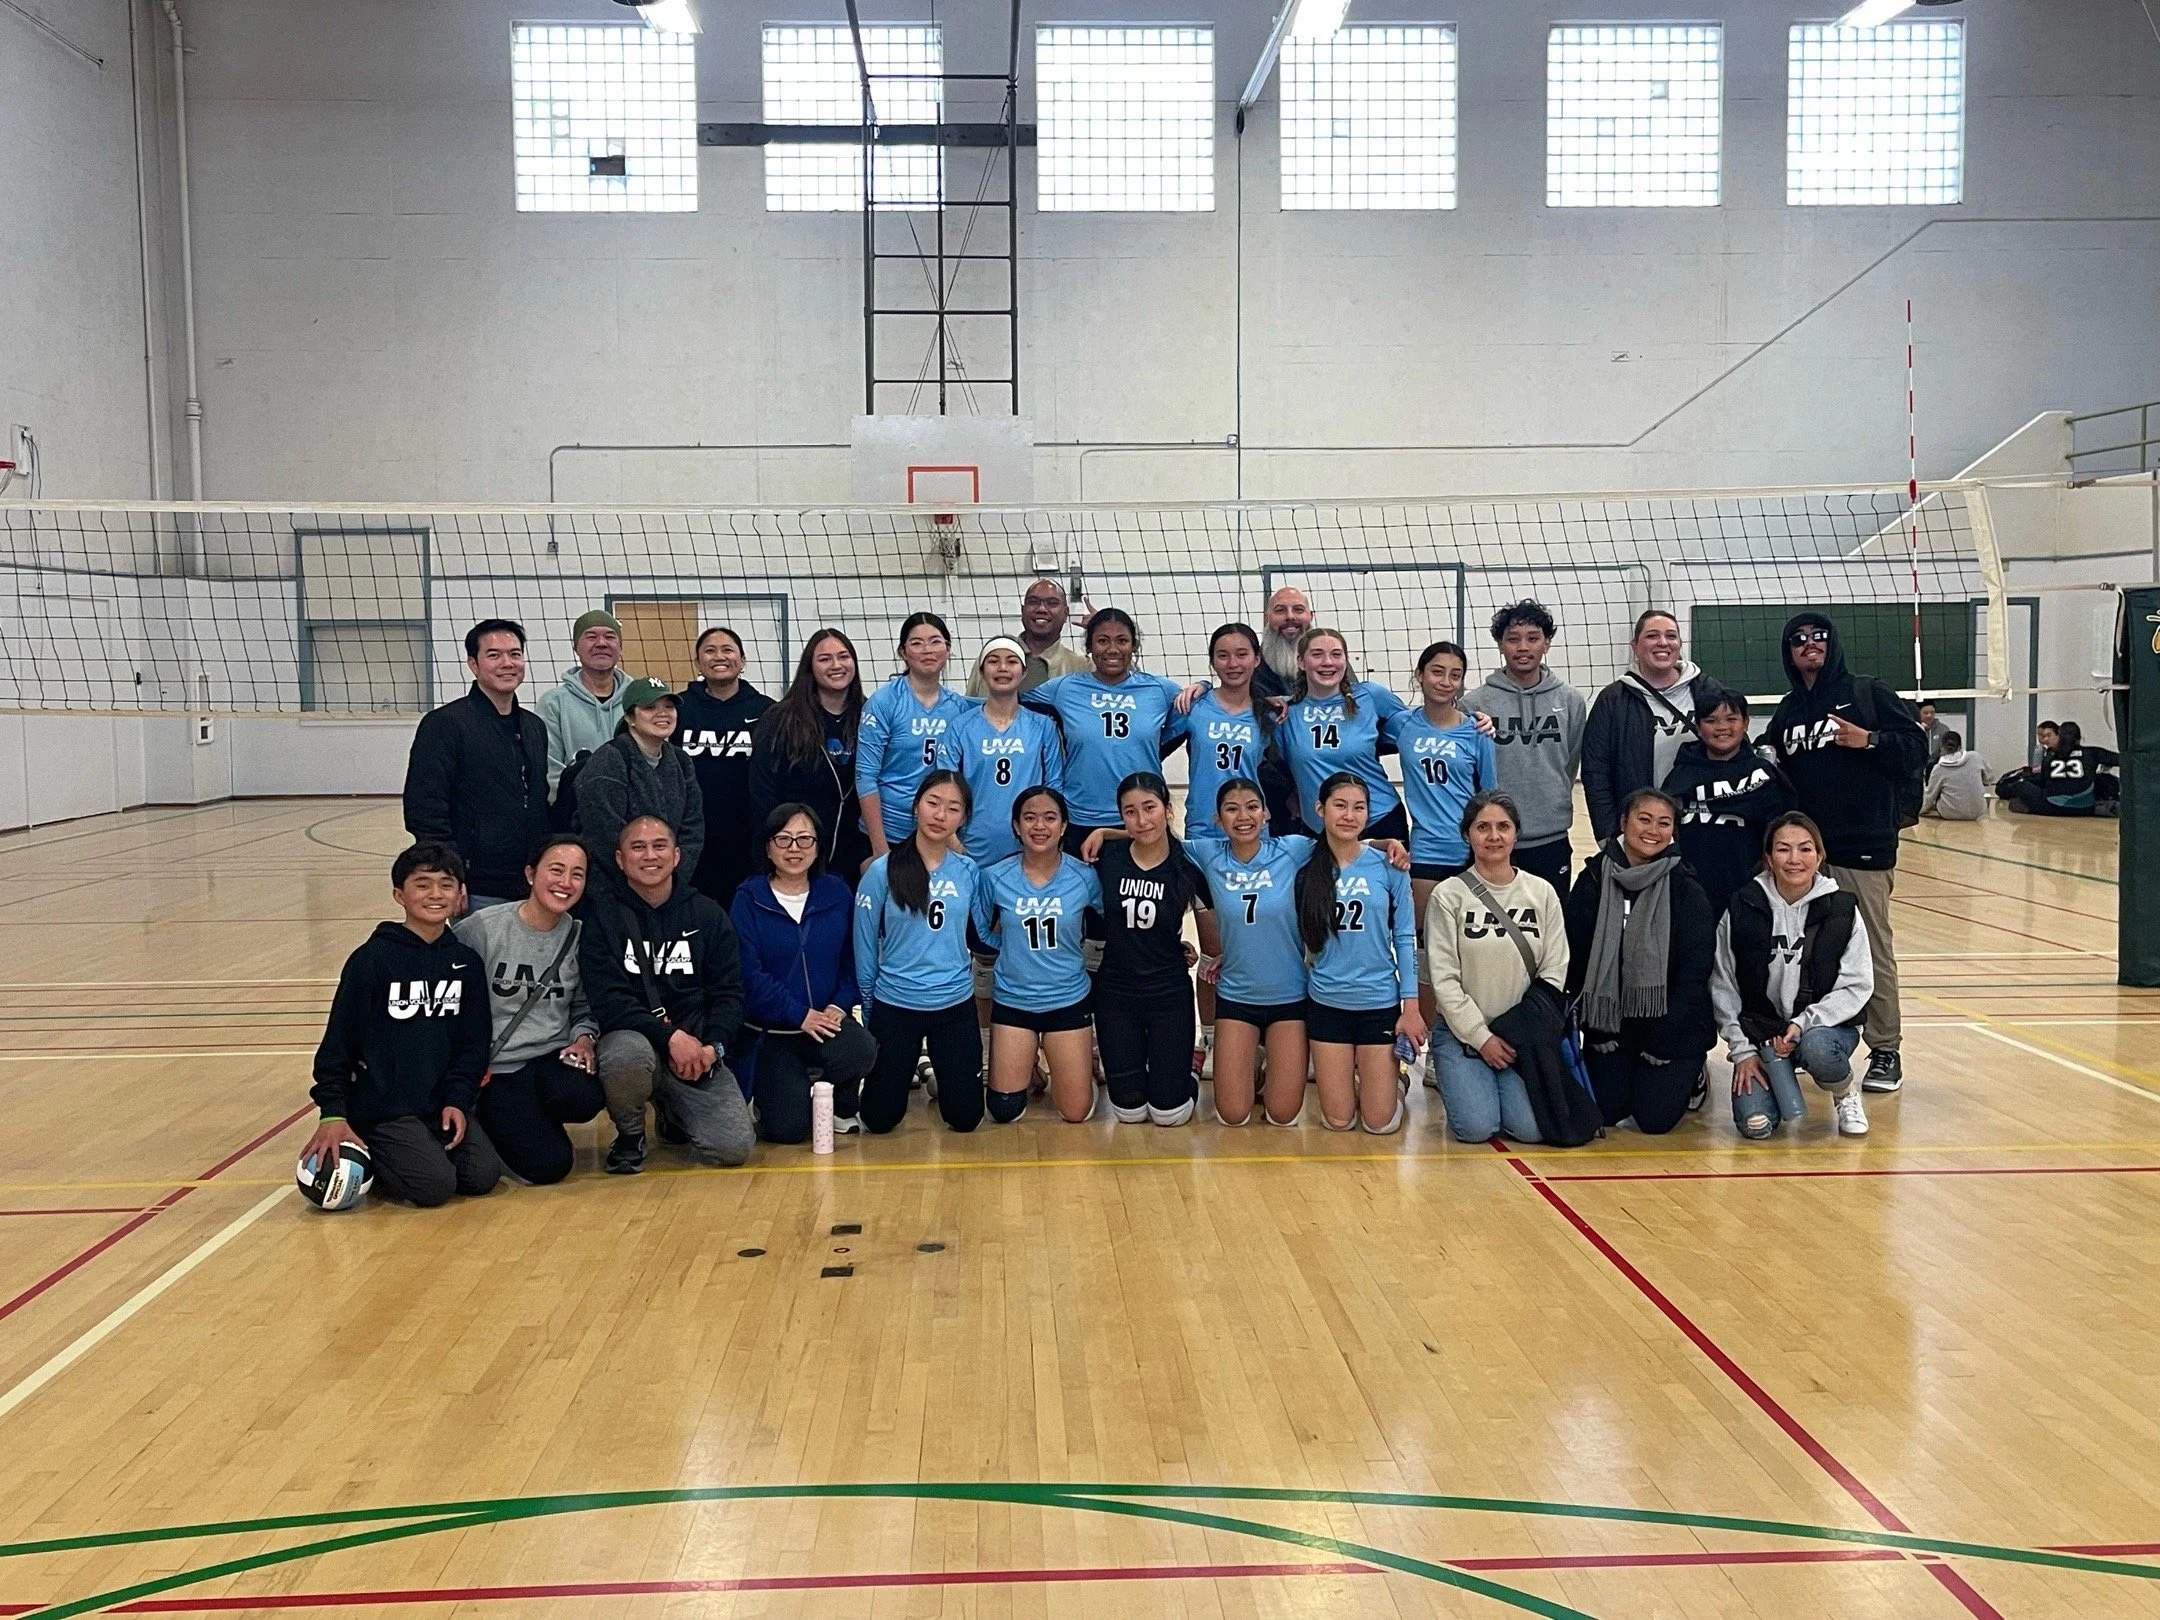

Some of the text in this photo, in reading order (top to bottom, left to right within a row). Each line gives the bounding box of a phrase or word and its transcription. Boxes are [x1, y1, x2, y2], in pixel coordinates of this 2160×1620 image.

[1090, 693, 1137, 710] UVA
[1303, 705, 1346, 723] UVA
[911, 717, 947, 736] UVA
[1100, 711, 1130, 739] 13
[1208, 721, 1252, 743] UVA
[1310, 723, 1341, 750] 14
[1491, 714, 1562, 746] UVA
[1783, 718, 1841, 756] UVA
[682, 729, 753, 757] UVA
[922, 737, 937, 767] 5
[981, 738, 1025, 755] UVA
[1216, 742, 1244, 771] 31
[1413, 737, 1457, 759] UVA
[994, 757, 1012, 786] 8
[1420, 757, 1450, 786] 10
[2050, 759, 2084, 779] 23
[929, 879, 959, 897] VA
[1119, 878, 1165, 901] UNION
[1225, 869, 1273, 892] UVA
[1335, 876, 1371, 896] VA
[926, 899, 946, 932] 6
[1015, 897, 1064, 916] UVA
[1121, 898, 1157, 930] 19
[1240, 892, 1259, 926] 7
[1335, 898, 1365, 932] 22
[1022, 915, 1059, 951] 11
[1464, 908, 1541, 939] UVA
[623, 938, 694, 975] UVA
[387, 979, 462, 1020] UVA
